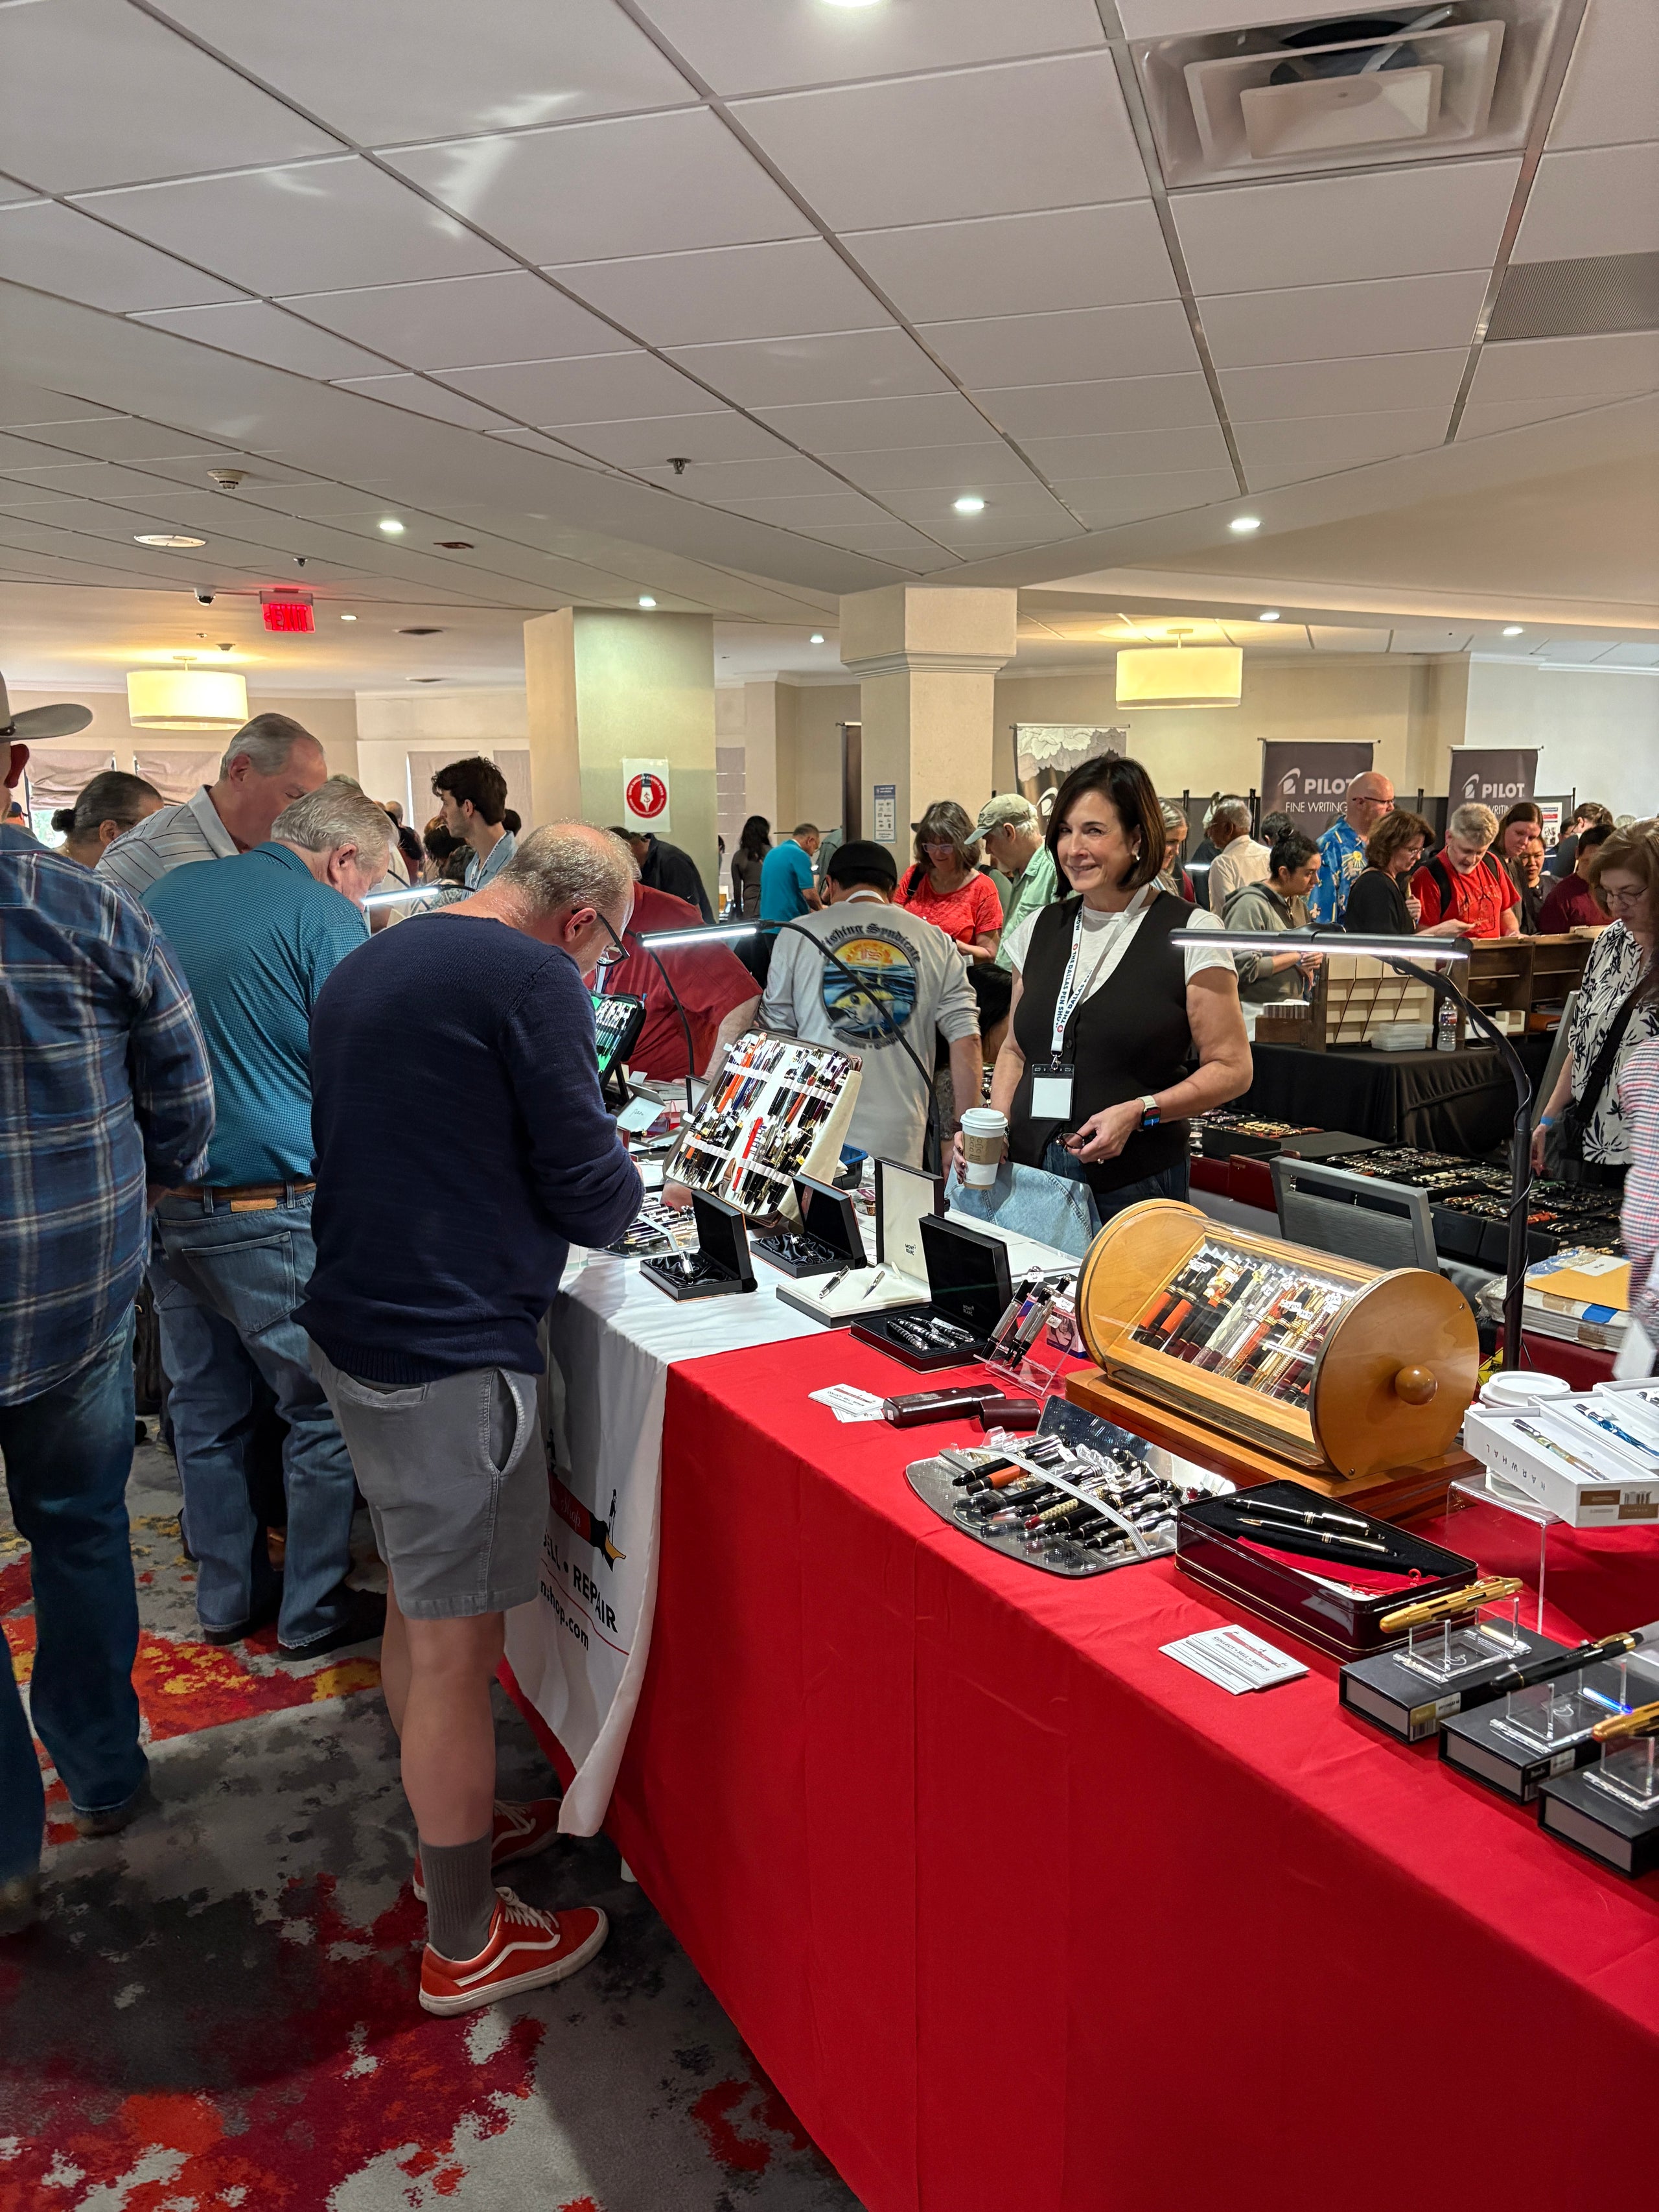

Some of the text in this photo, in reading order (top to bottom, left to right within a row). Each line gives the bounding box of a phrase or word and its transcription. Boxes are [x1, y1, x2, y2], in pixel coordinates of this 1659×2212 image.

[270, 603, 308, 631] EXIT
[1285, 801, 1348, 813] FINE WRITING
[1481, 783, 1525, 798] PILOT
[819, 923, 920, 963] ishing Syndicate
[1063, 964, 1074, 990] DALLAS
[1056, 1006, 1064, 1028] SHO
[1060, 984, 1085, 1023] THE DALLAS
[1486, 1443, 1546, 1491] NARWHAL
[561, 1496, 581, 1531] Shop
[573, 1564, 618, 1633] REPAIR
[1213, 1636, 1236, 1649] COLLECT
[1237, 1650, 1249, 1659] SELL
[1251, 1659, 1270, 1671] REPAIR
